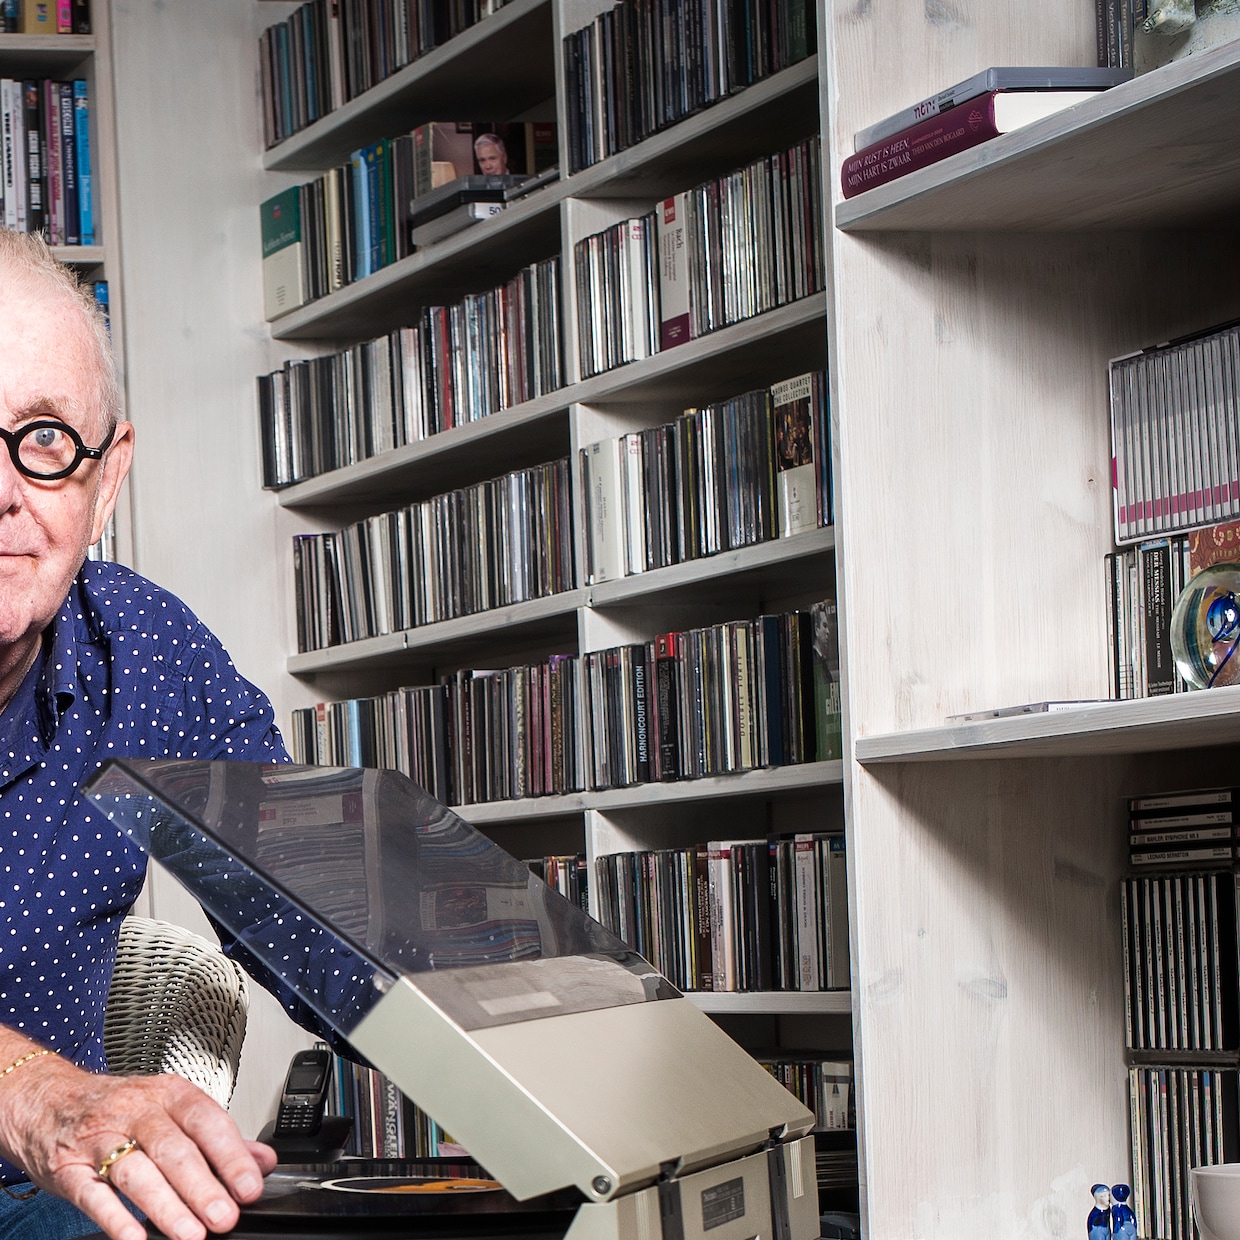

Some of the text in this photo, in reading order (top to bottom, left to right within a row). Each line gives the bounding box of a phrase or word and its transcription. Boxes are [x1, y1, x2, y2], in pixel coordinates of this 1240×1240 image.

[1110, 48, 1116, 62] de
[914, 100, 936, 119] ntr:
[912, 127, 965, 156] THEO VAN DEN BOGAARD
[65, 138, 75, 188] L'INNOCENTE
[847, 160, 863, 174] MIJN
[863, 149, 881, 167] RUST
[882, 147, 889, 159] IS
[848, 151, 912, 187] MIJN HART IS ZWAAR
[676, 228, 684, 249] Bach
[782, 386, 810, 402] COLLECTION
[790, 376, 811, 390] QUARTET
[636, 666, 647, 762] HARNONCOURT EDITION
[1147, 851, 1189, 860] LEONARD BERNSTEIN
[387, 1082, 398, 1159] WÄNGLER
